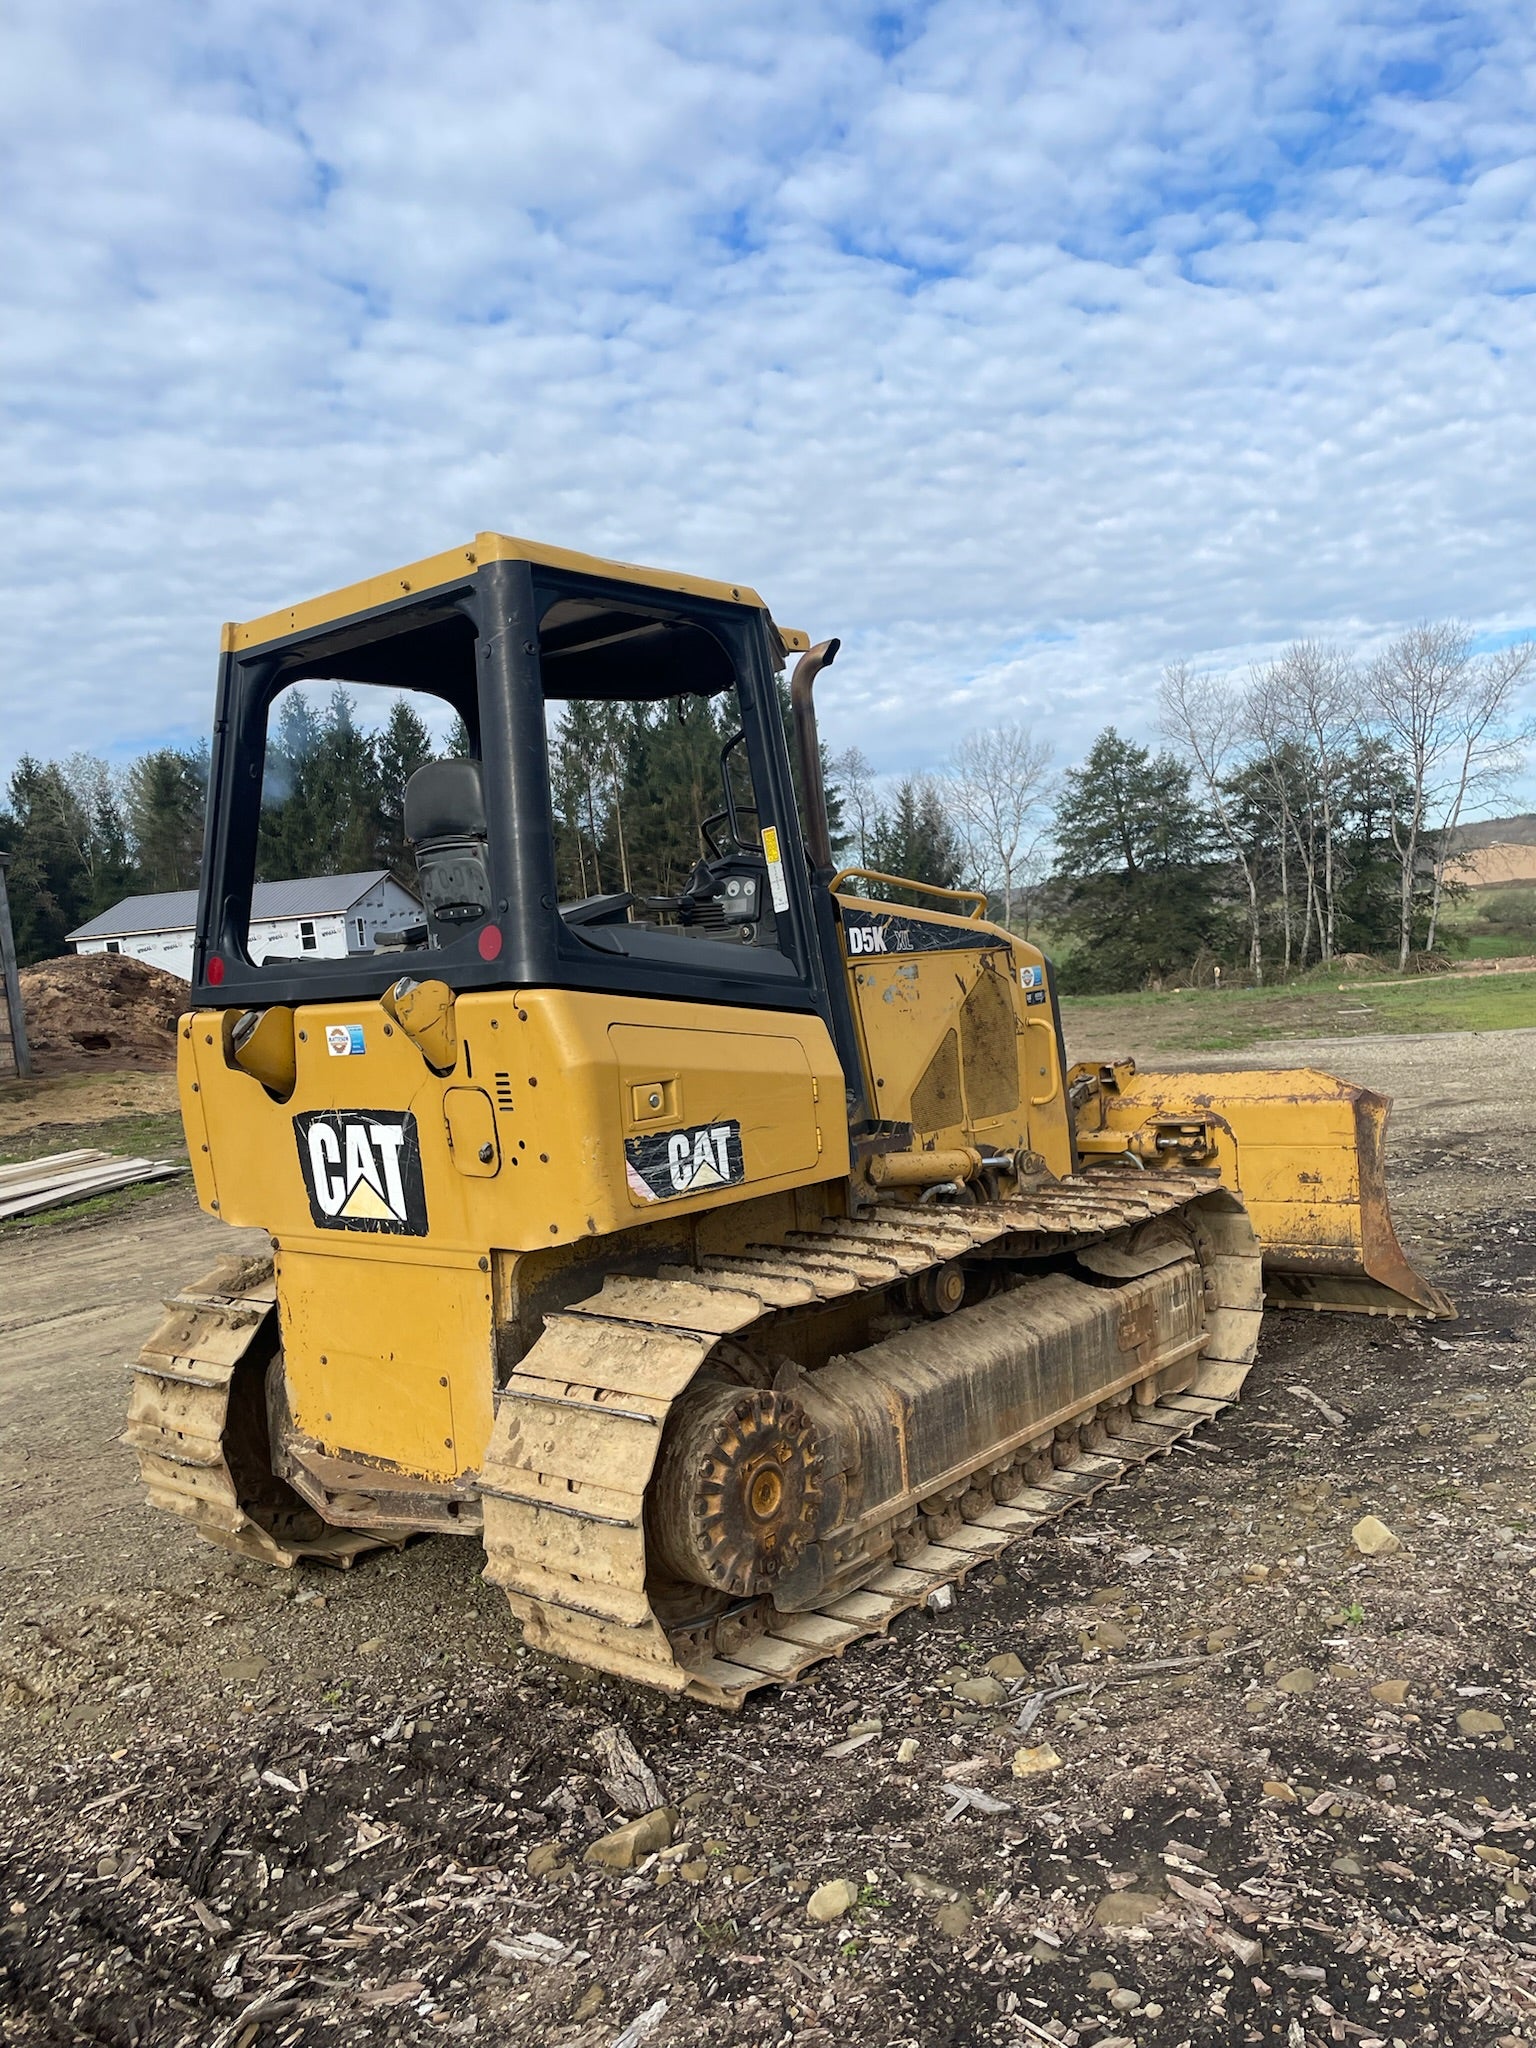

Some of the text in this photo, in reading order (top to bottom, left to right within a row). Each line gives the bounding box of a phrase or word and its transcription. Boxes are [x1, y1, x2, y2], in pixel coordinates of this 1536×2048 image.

[849, 926, 888, 954] D5K
[308, 1122, 407, 1221] CAT
[668, 1126, 731, 1190] CAT
